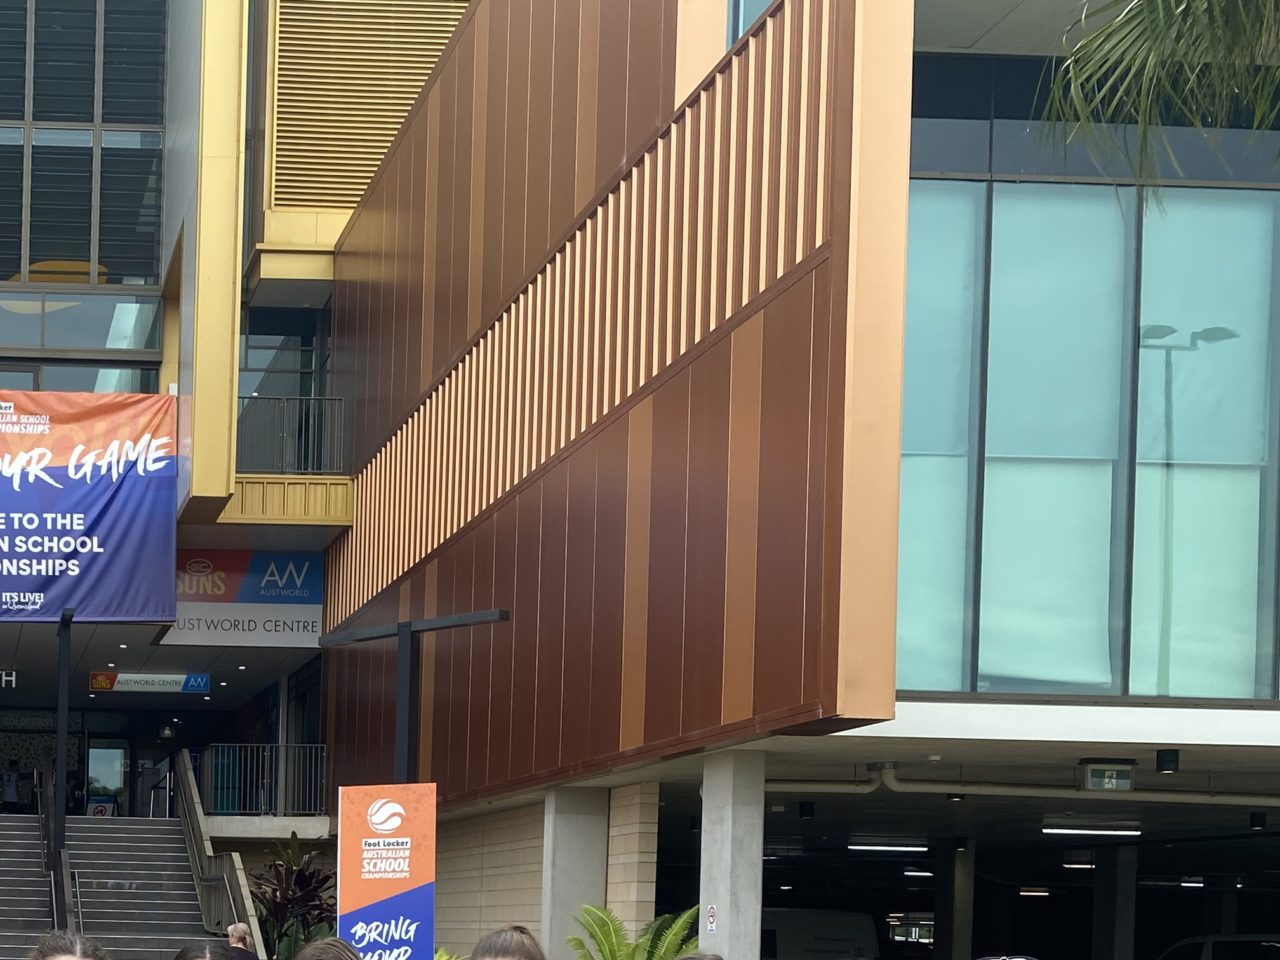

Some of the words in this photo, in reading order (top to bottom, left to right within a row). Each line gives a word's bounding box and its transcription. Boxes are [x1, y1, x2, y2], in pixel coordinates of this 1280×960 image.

[20, 415, 50, 424] SCHOOL
[68, 433, 173, 484] GAME
[10, 513, 39, 529] TO
[43, 513, 84, 530] THE
[14, 536, 104, 553] SCHOOL
[1, 592, 19, 602] IT'S
[20, 592, 44, 602] LIVE!
[260, 588, 309, 597] AUSTWORLD
[173, 618, 257, 632] USTWORLD
[263, 620, 319, 633] CENTRE
[364, 840, 380, 848] Foot
[362, 850, 410, 859] AUSTRALIAN
[362, 858, 410, 872] SCHOOL
[350, 916, 421, 948] BRING
